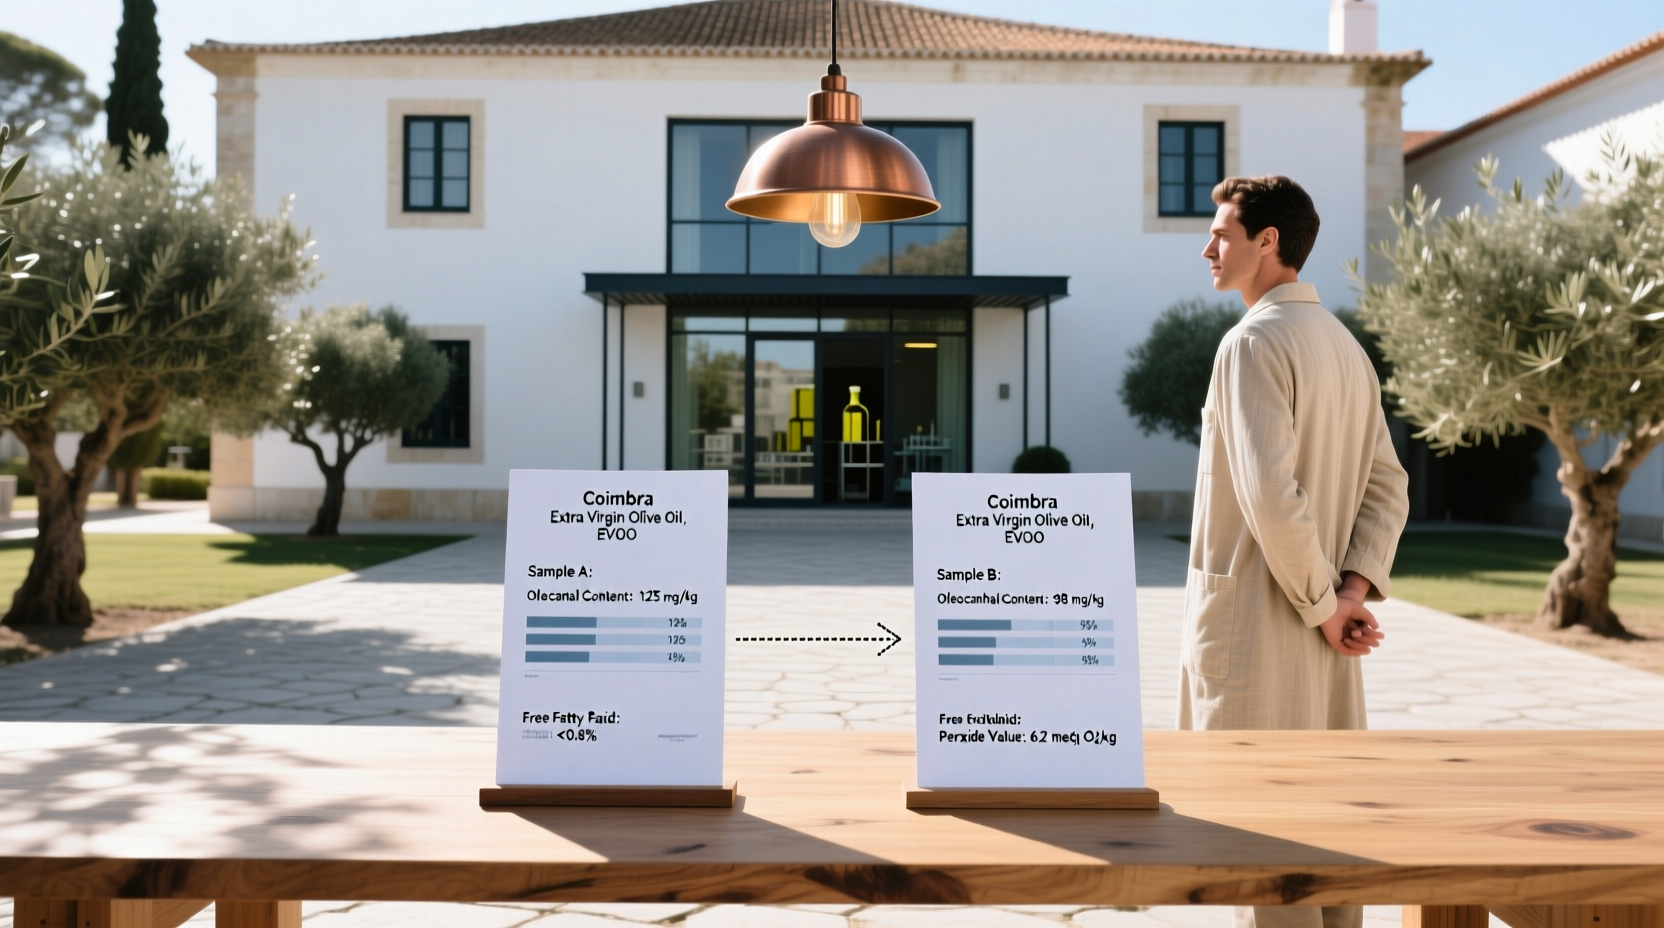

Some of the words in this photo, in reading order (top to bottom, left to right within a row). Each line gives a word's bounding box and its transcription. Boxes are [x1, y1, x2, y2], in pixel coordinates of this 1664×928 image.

[583, 490, 653, 506] Coimbra
[988, 493, 1057, 509] Coimbra
[551, 510, 584, 523] Extra
[587, 510, 625, 528] Virgin
[629, 510, 661, 524] Olive
[665, 511, 686, 525] Oil,
[957, 514, 989, 526] Extra
[993, 513, 1031, 531] Virgin
[1035, 513, 1068, 526] Olive
[1072, 514, 1094, 530] Oil,
[598, 527, 637, 540] EVOO
[1005, 530, 1044, 543] EVOO
[528, 565, 575, 580] Sample
[578, 566, 592, 577] A:
[937, 568, 984, 583] Sample
[987, 568, 1000, 581] B:
[523, 712, 549, 723] Free
